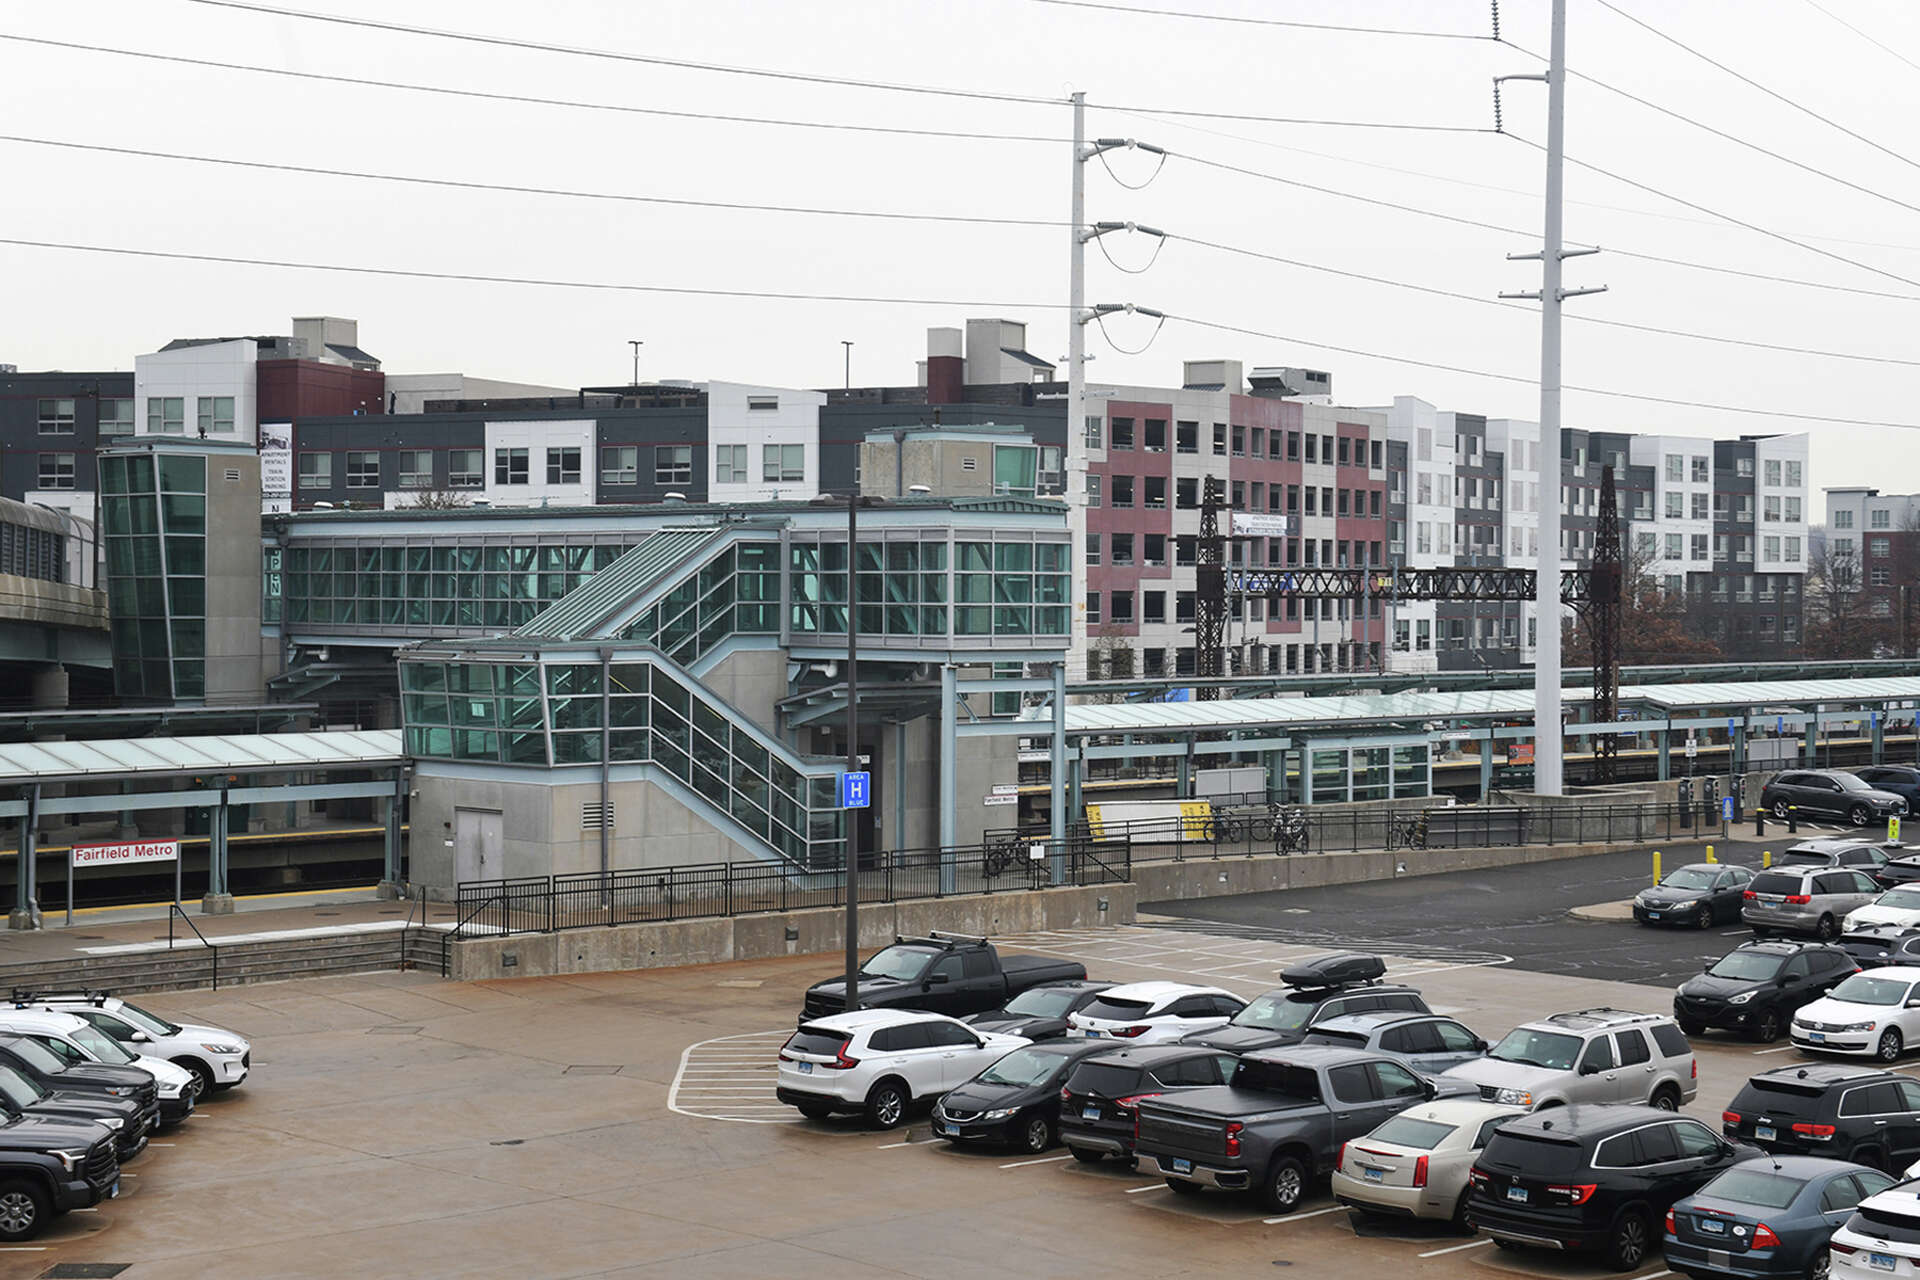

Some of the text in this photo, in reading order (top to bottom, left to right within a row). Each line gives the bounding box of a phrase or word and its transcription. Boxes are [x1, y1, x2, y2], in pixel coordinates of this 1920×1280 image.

[851, 782, 862, 798] H
[75, 844, 173, 861] Fairfield Metro
